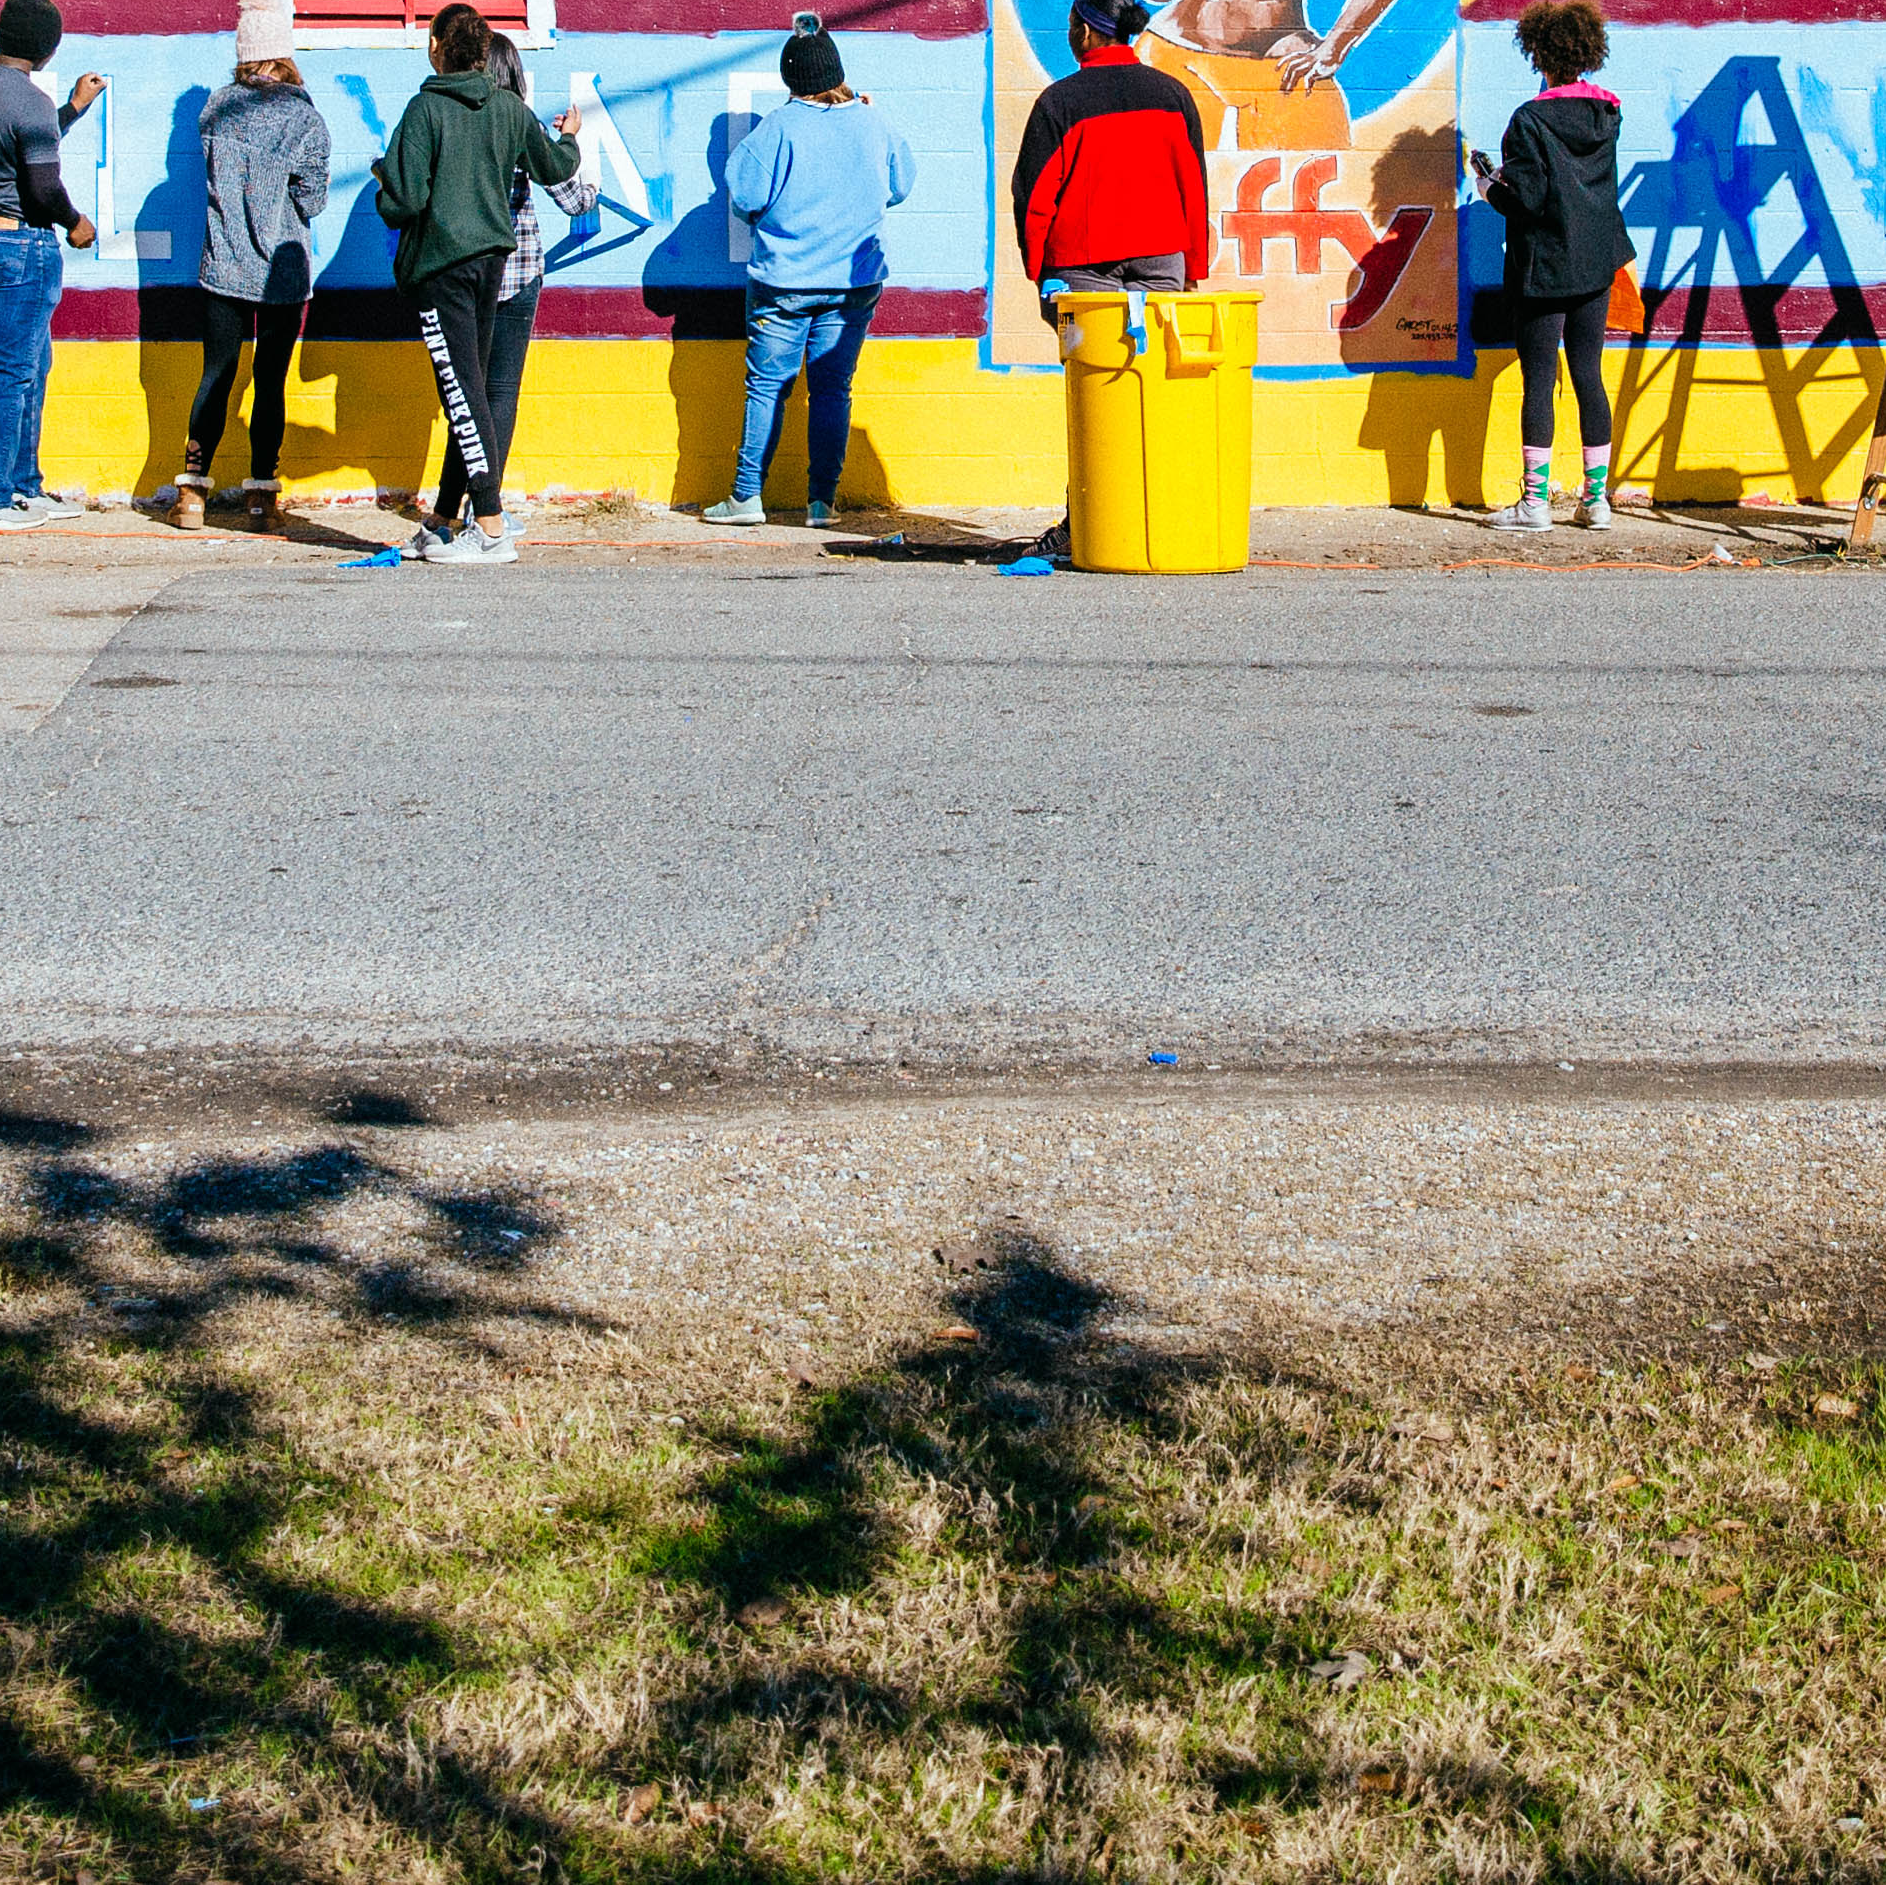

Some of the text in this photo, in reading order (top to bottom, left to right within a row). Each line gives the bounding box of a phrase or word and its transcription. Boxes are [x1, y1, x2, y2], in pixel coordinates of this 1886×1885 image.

[1207, 153, 1435, 331] ffy
[419, 308, 489, 479] PINK PINK PINK
